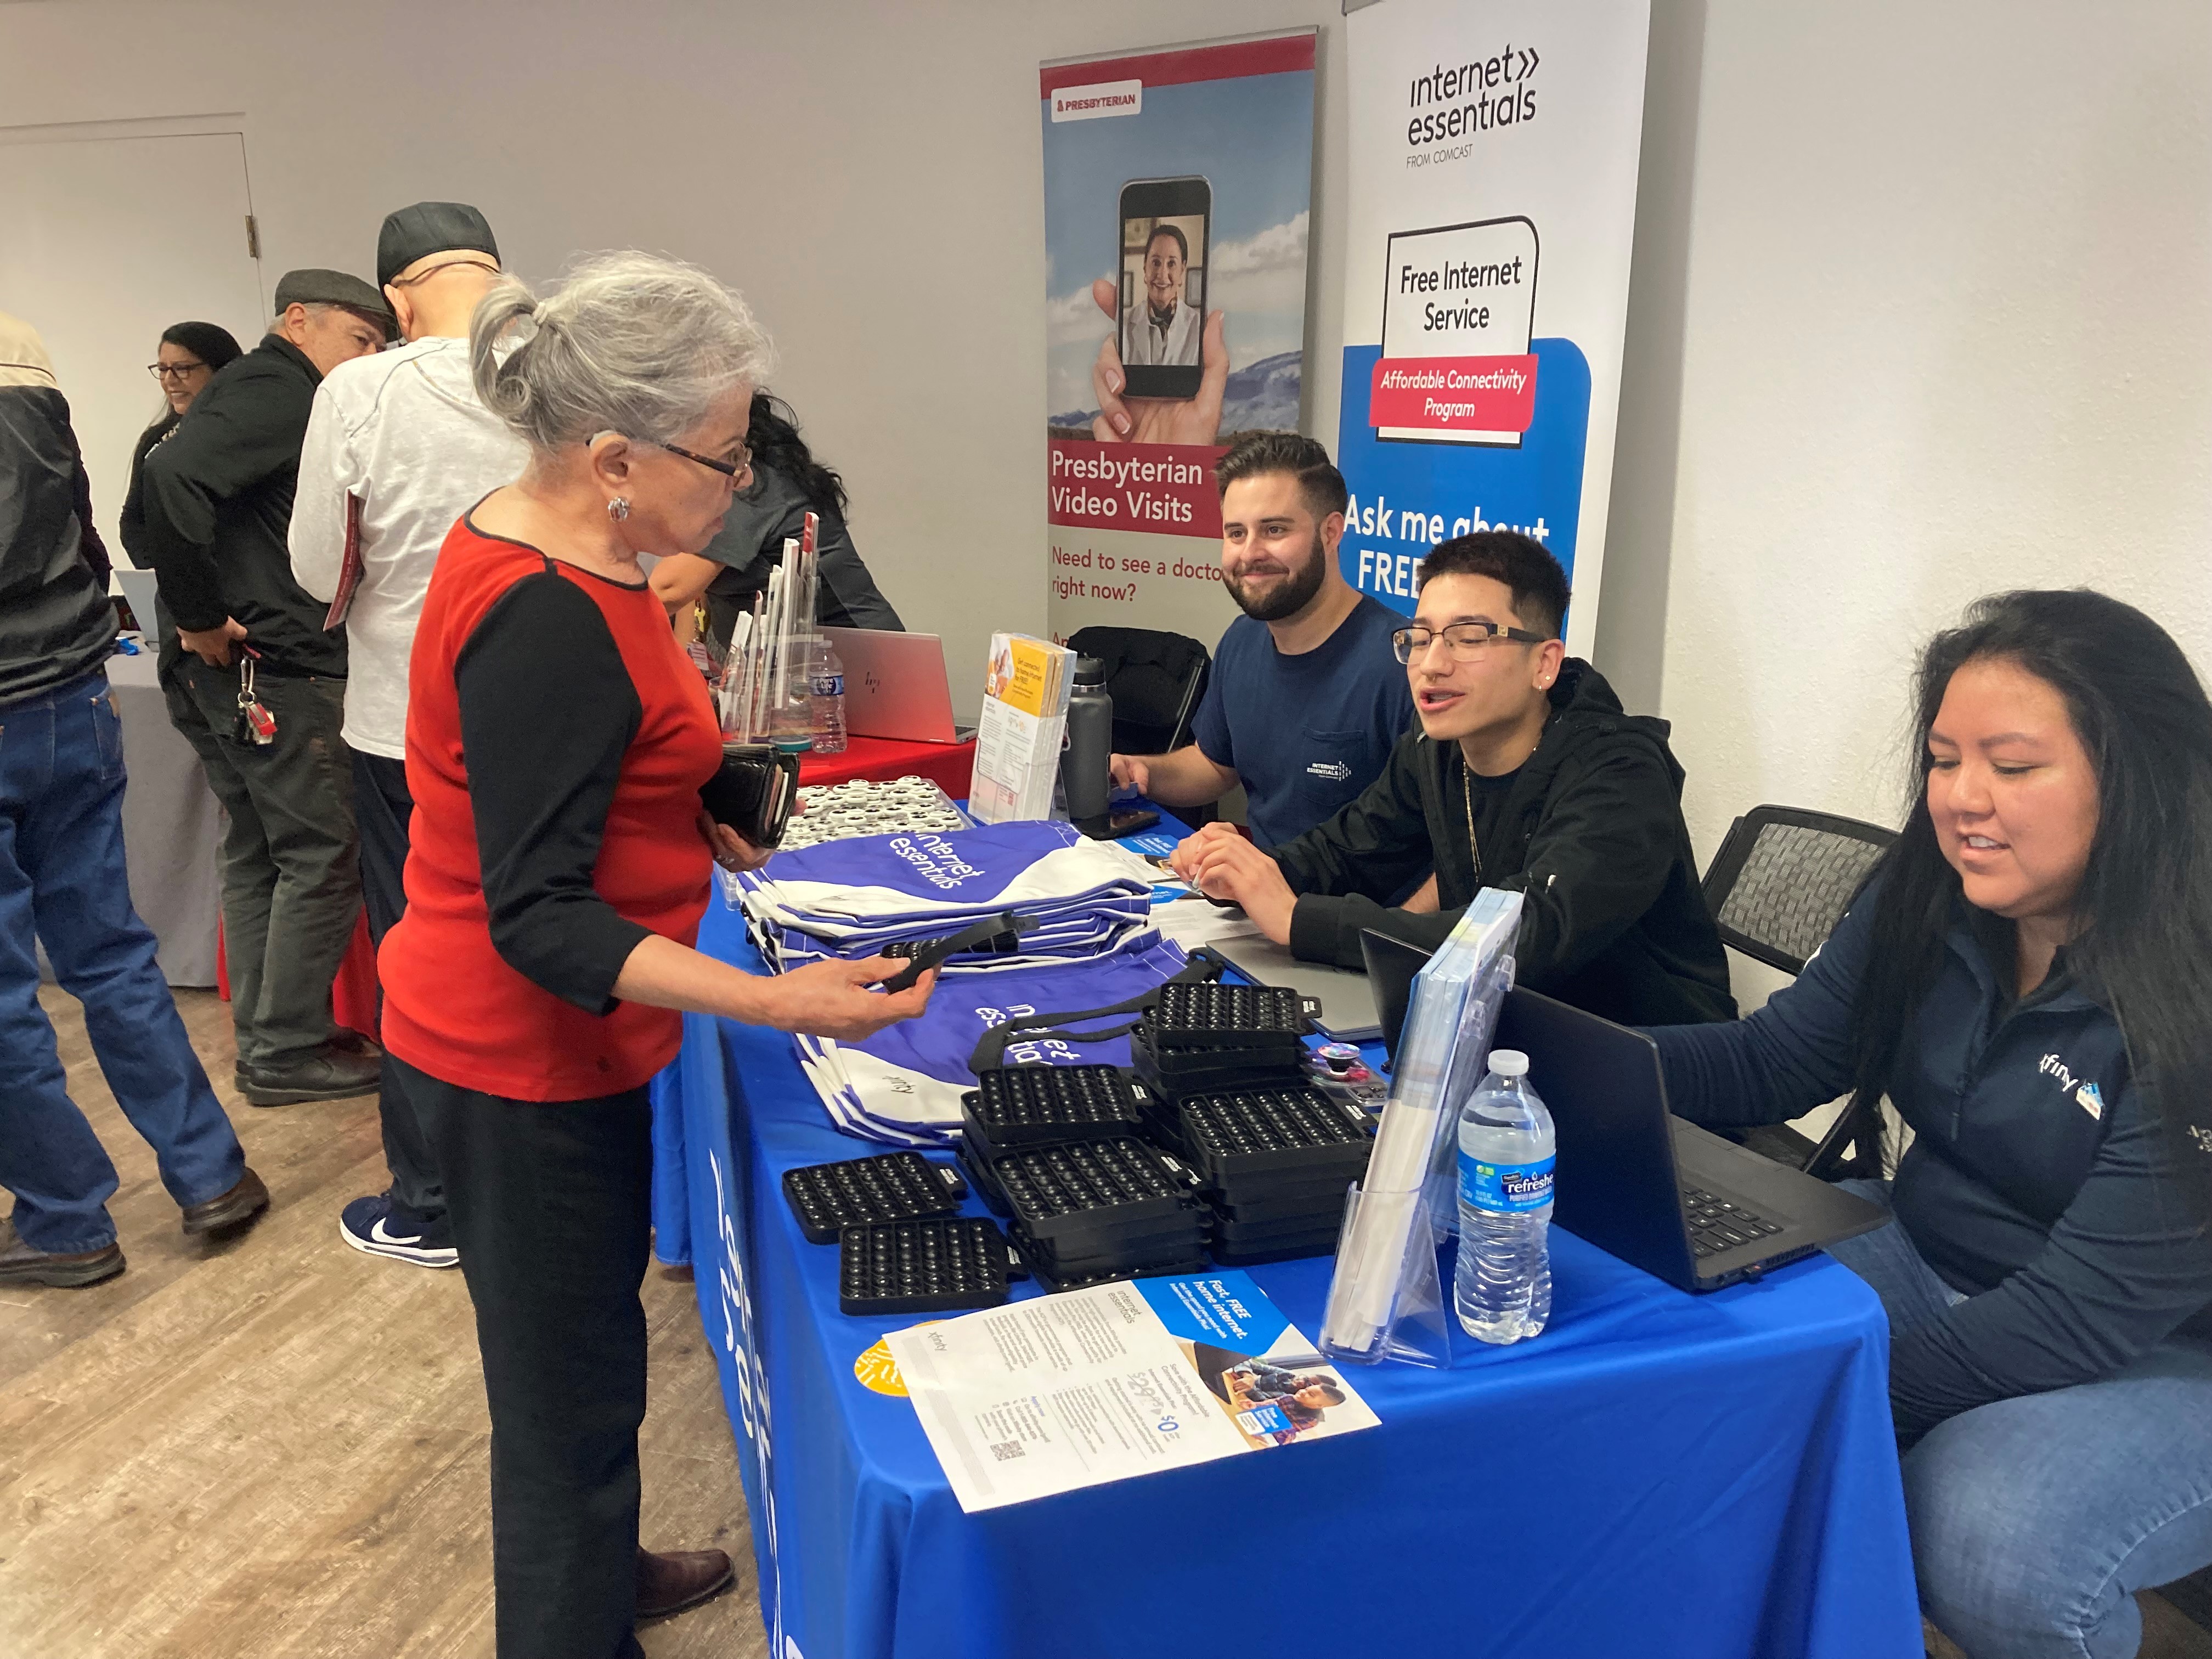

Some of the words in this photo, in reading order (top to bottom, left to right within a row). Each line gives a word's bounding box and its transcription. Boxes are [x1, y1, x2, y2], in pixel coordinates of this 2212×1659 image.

[1410, 43, 1514, 108] internet
[1065, 94, 1136, 111] PRESBYTERIAN
[1408, 83, 1536, 146] essentials
[1406, 154, 1430, 168] FROM
[1434, 144, 1473, 164] COMCAST
[1401, 265, 1438, 294] Free
[1444, 256, 1522, 290] Internet
[1424, 298, 1489, 331] Service
[1380, 369, 1445, 390] Affordable
[1447, 369, 1527, 394] Connectivity
[1424, 398, 1475, 422] Program
[1052, 450, 1202, 488] Presbyterian
[1052, 486, 1118, 516] Video
[1126, 491, 1192, 523] Visits
[1343, 494, 1392, 539] Ask
[1401, 510, 1444, 545] me
[1452, 506, 1550, 543] abt
[1052, 546, 1092, 568] Need
[1098, 552, 1115, 570] to
[1122, 558, 1150, 574] see
[1156, 562, 1166, 575] a
[1172, 557, 1222, 582] docto
[1358, 549, 1425, 599] FREE
[1052, 577, 1085, 599] right
[1092, 583, 1136, 602] now?
[865, 672, 881, 693] hp
[1307, 767, 1339, 776] ESSENTIALS
[1312, 763, 1339, 771] INTERNET
[1108, 1292, 1135, 1324] essentials
[1117, 1290, 1141, 1316] internet
[1193, 1281, 1217, 1303] home
[1212, 1304, 1248, 1339] internet.
[1209, 1280, 1230, 1298] Fast,
[1225, 1299, 1252, 1319] FREE
[928, 1331, 948, 1352] xfinity
[1158, 1415, 1179, 1432] $0
